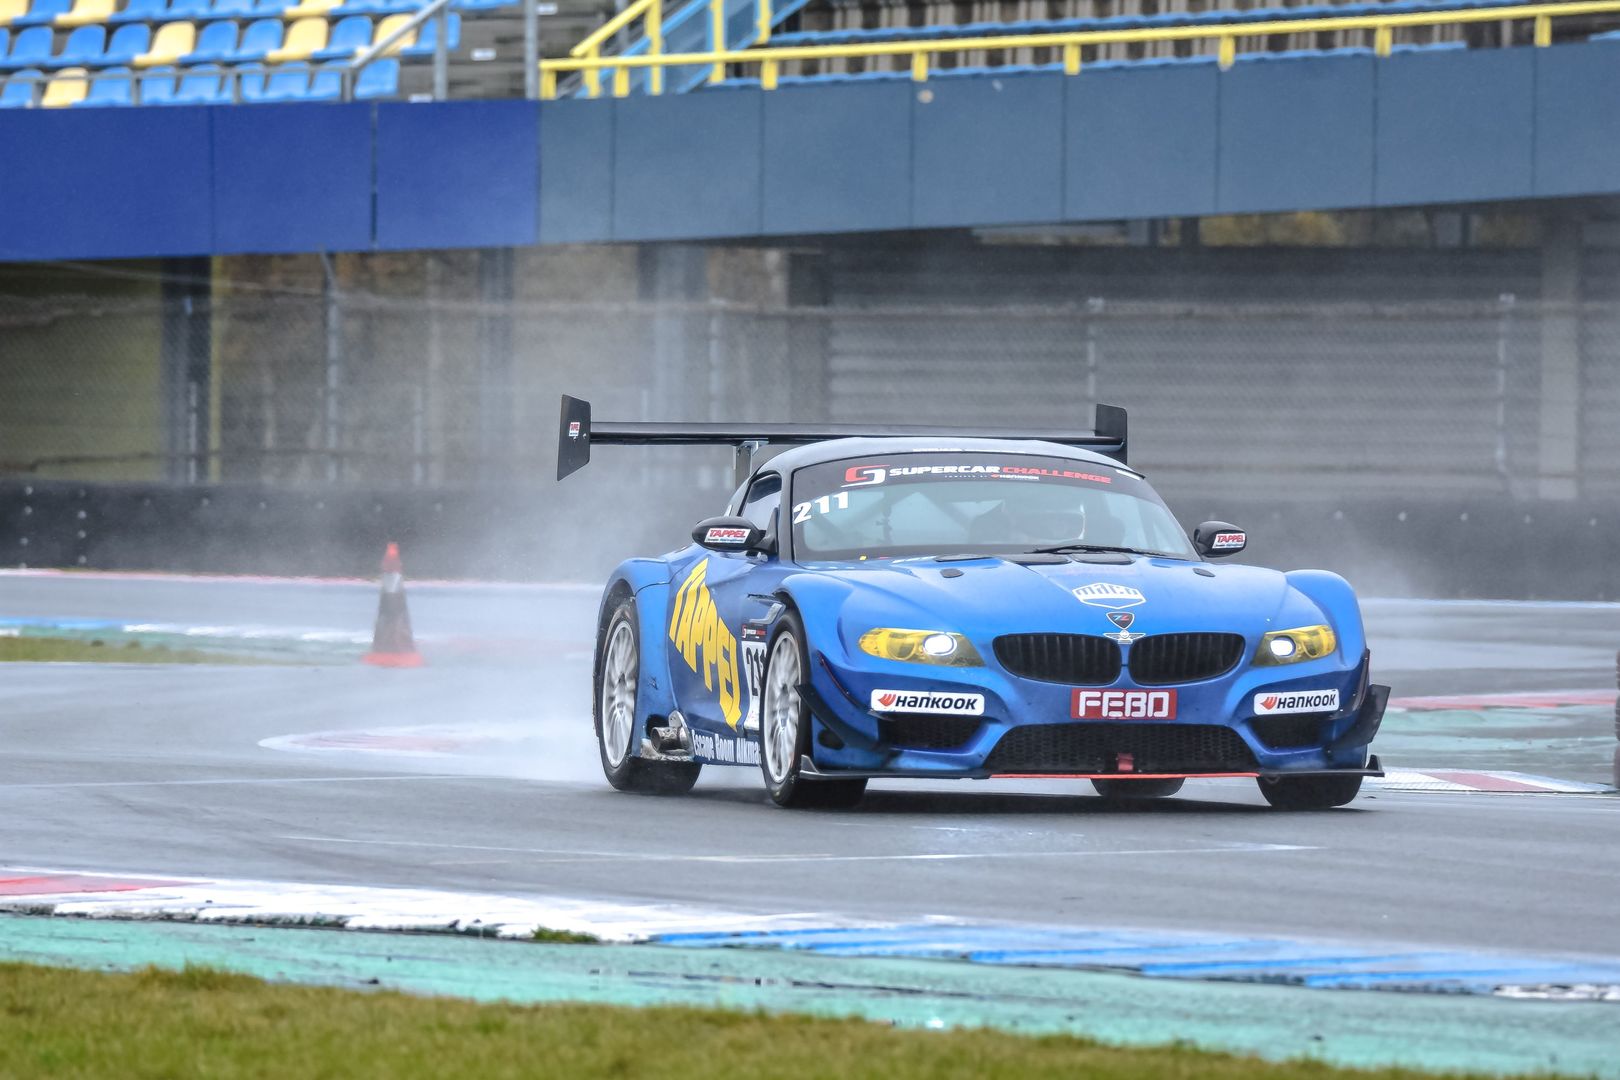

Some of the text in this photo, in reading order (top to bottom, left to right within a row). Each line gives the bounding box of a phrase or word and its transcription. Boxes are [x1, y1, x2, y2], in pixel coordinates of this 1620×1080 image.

[889, 465, 1112, 484] SUPERCAR CHALLENGE
[792, 491, 849, 525] 211
[669, 558, 742, 733] TAPPEL
[1078, 691, 1170, 718] FEBO
[736, 737, 762, 765] Alkma
